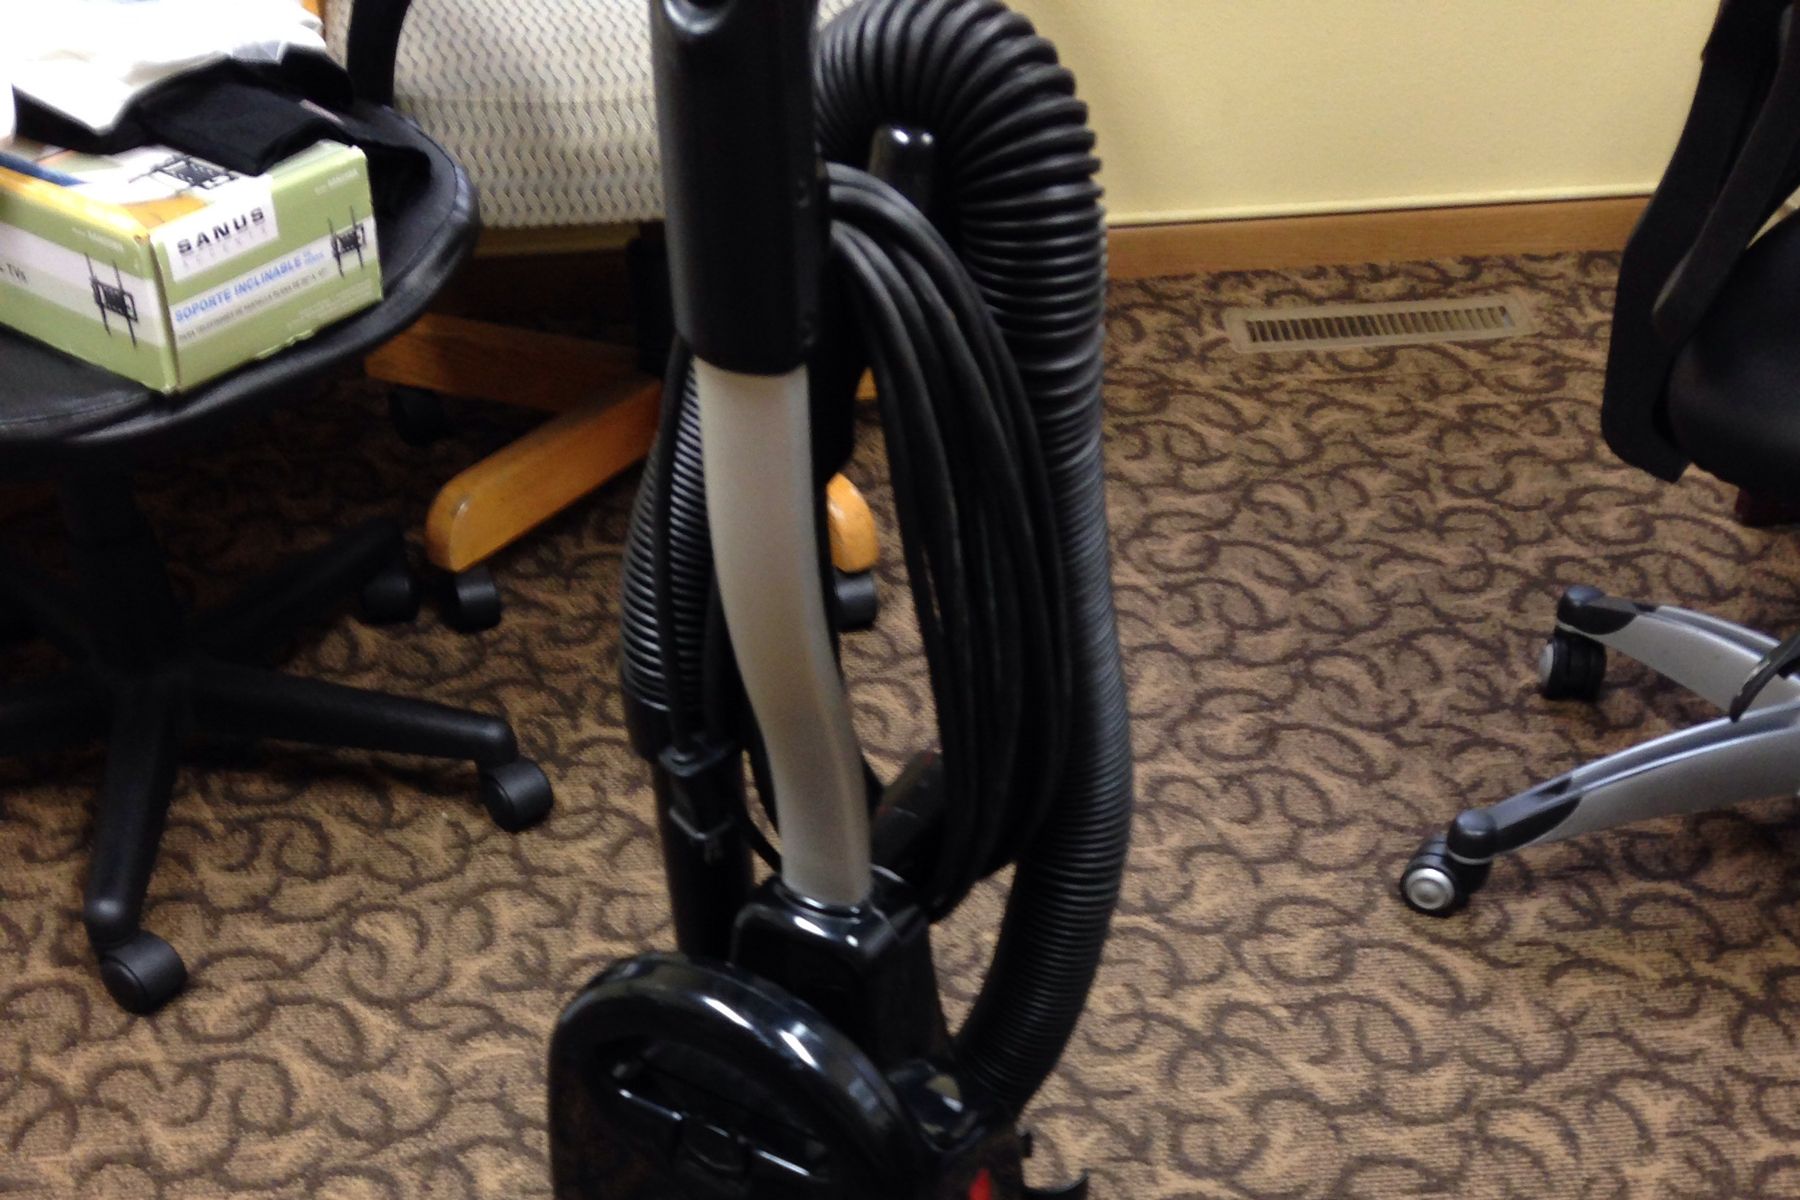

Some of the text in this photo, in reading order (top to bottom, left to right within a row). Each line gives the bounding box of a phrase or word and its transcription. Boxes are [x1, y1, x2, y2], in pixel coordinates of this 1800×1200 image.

[177, 207, 264, 254] SANUS
[175, 292, 231, 323] SOPORTE
[234, 257, 301, 297] INCLINABLE
